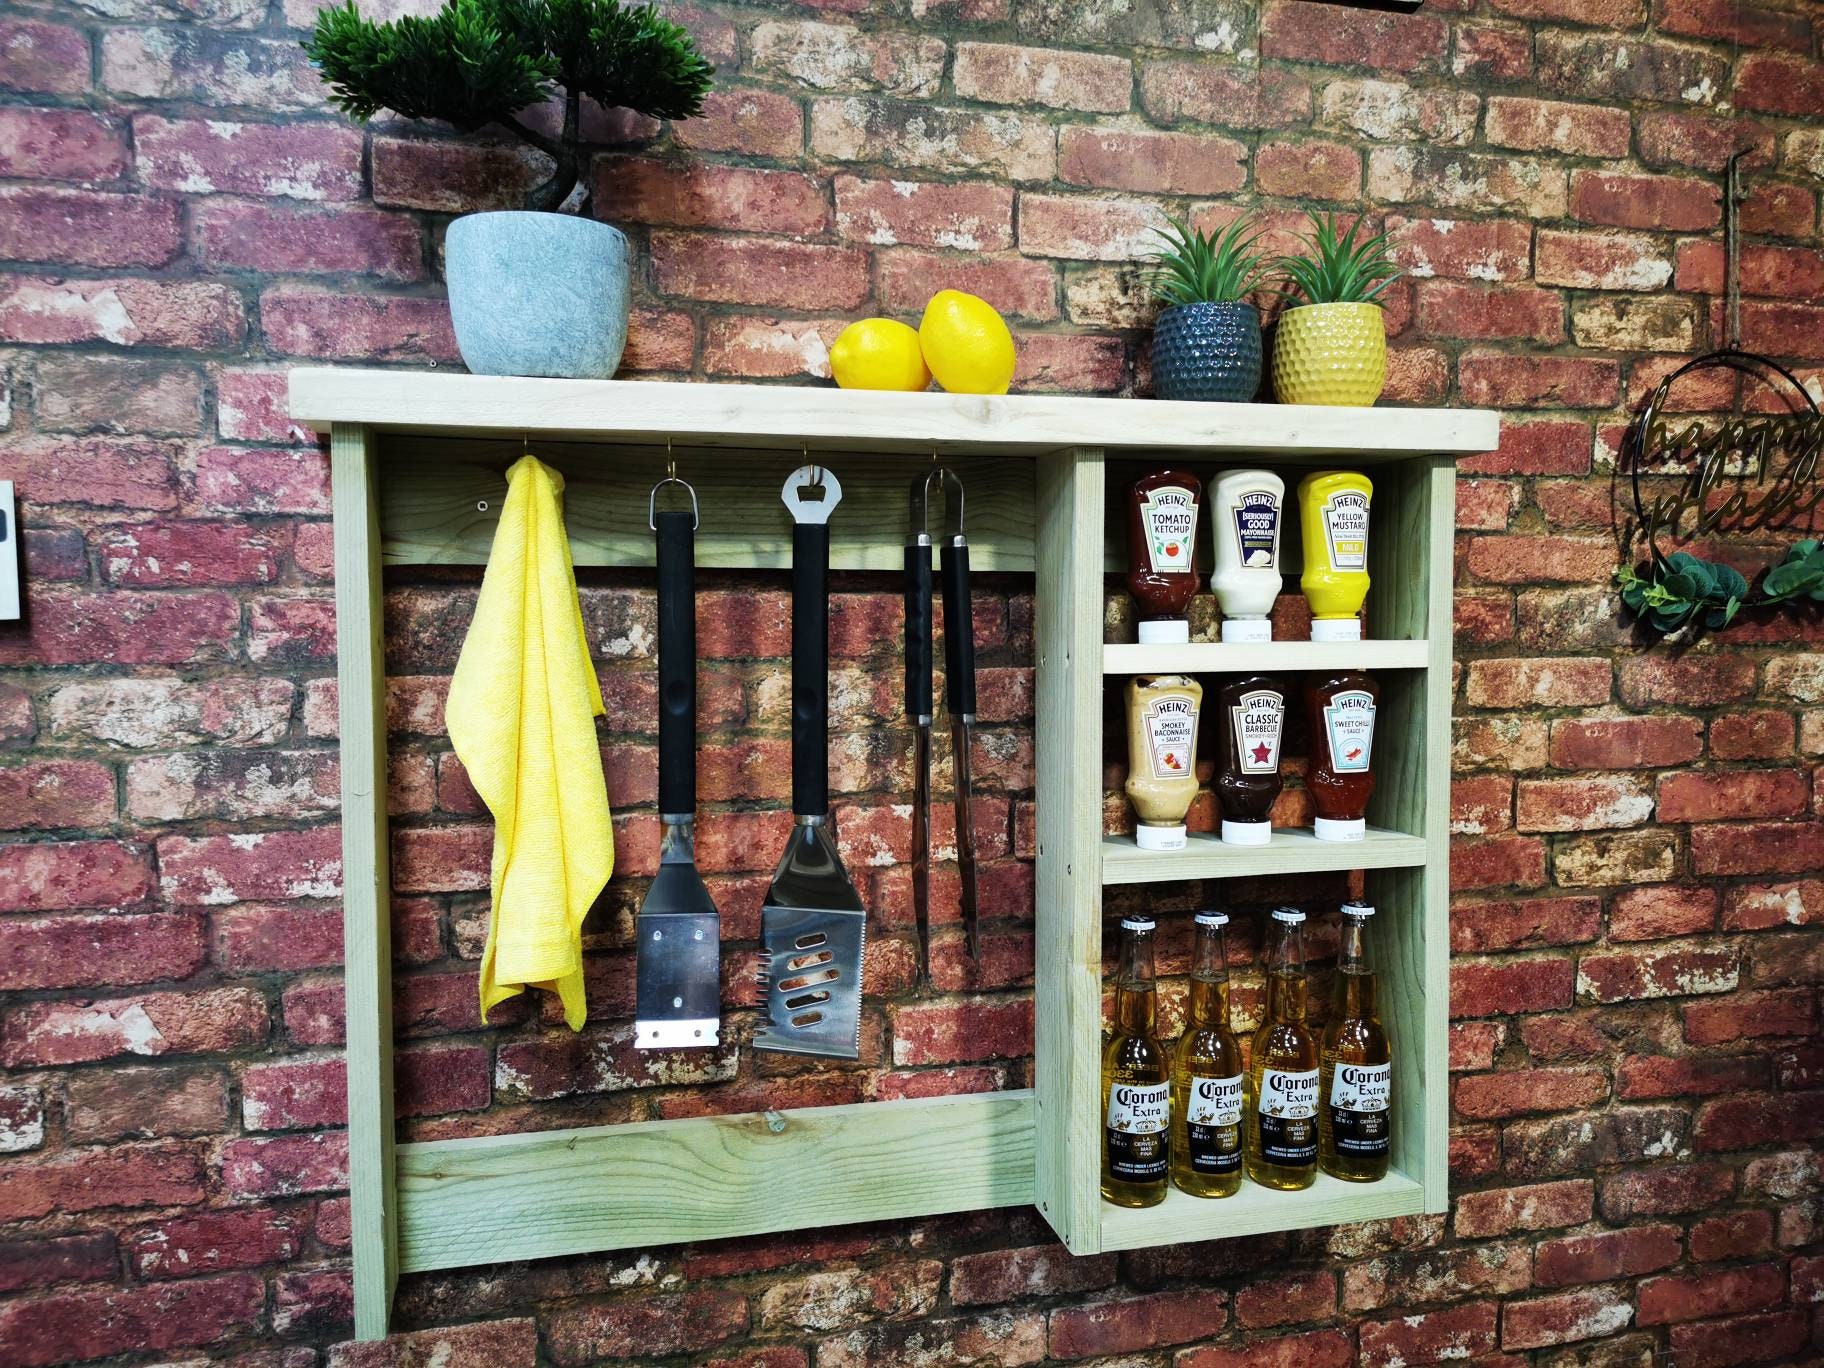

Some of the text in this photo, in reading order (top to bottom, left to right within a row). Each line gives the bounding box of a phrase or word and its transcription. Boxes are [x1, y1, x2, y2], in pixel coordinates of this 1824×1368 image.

[1642, 375, 1824, 498] happy
[1157, 495, 1186, 506] HEINZ
[1245, 495, 1273, 507] HEINZ
[1337, 497, 1364, 508] HEINZ
[1152, 514, 1191, 524] TOMATO
[1248, 520, 1270, 528] GOOD
[1155, 525, 1190, 533] KETCHUP
[1332, 521, 1366, 529] MUSTARD
[1241, 528, 1275, 536] MAYONNAISE
[1342, 543, 1359, 551] MILD
[1159, 702, 1187, 714] HEINZ
[1250, 698, 1277, 709] HEINZ
[1341, 698, 1368, 709] HEINZ
[1245, 714, 1279, 724] CLASSIC
[1161, 722, 1186, 730] SMOKEY
[1245, 724, 1277, 732] BARBECUE
[1154, 728, 1191, 737] BACONNAISE
[1359, 1084, 1386, 1095] Extra
[1116, 1088, 1168, 1108] Corona
[1286, 1091, 1313, 1102] Extra
[1216, 1098, 1240, 1109] Extra
[1132, 1105, 1161, 1117] Extra
